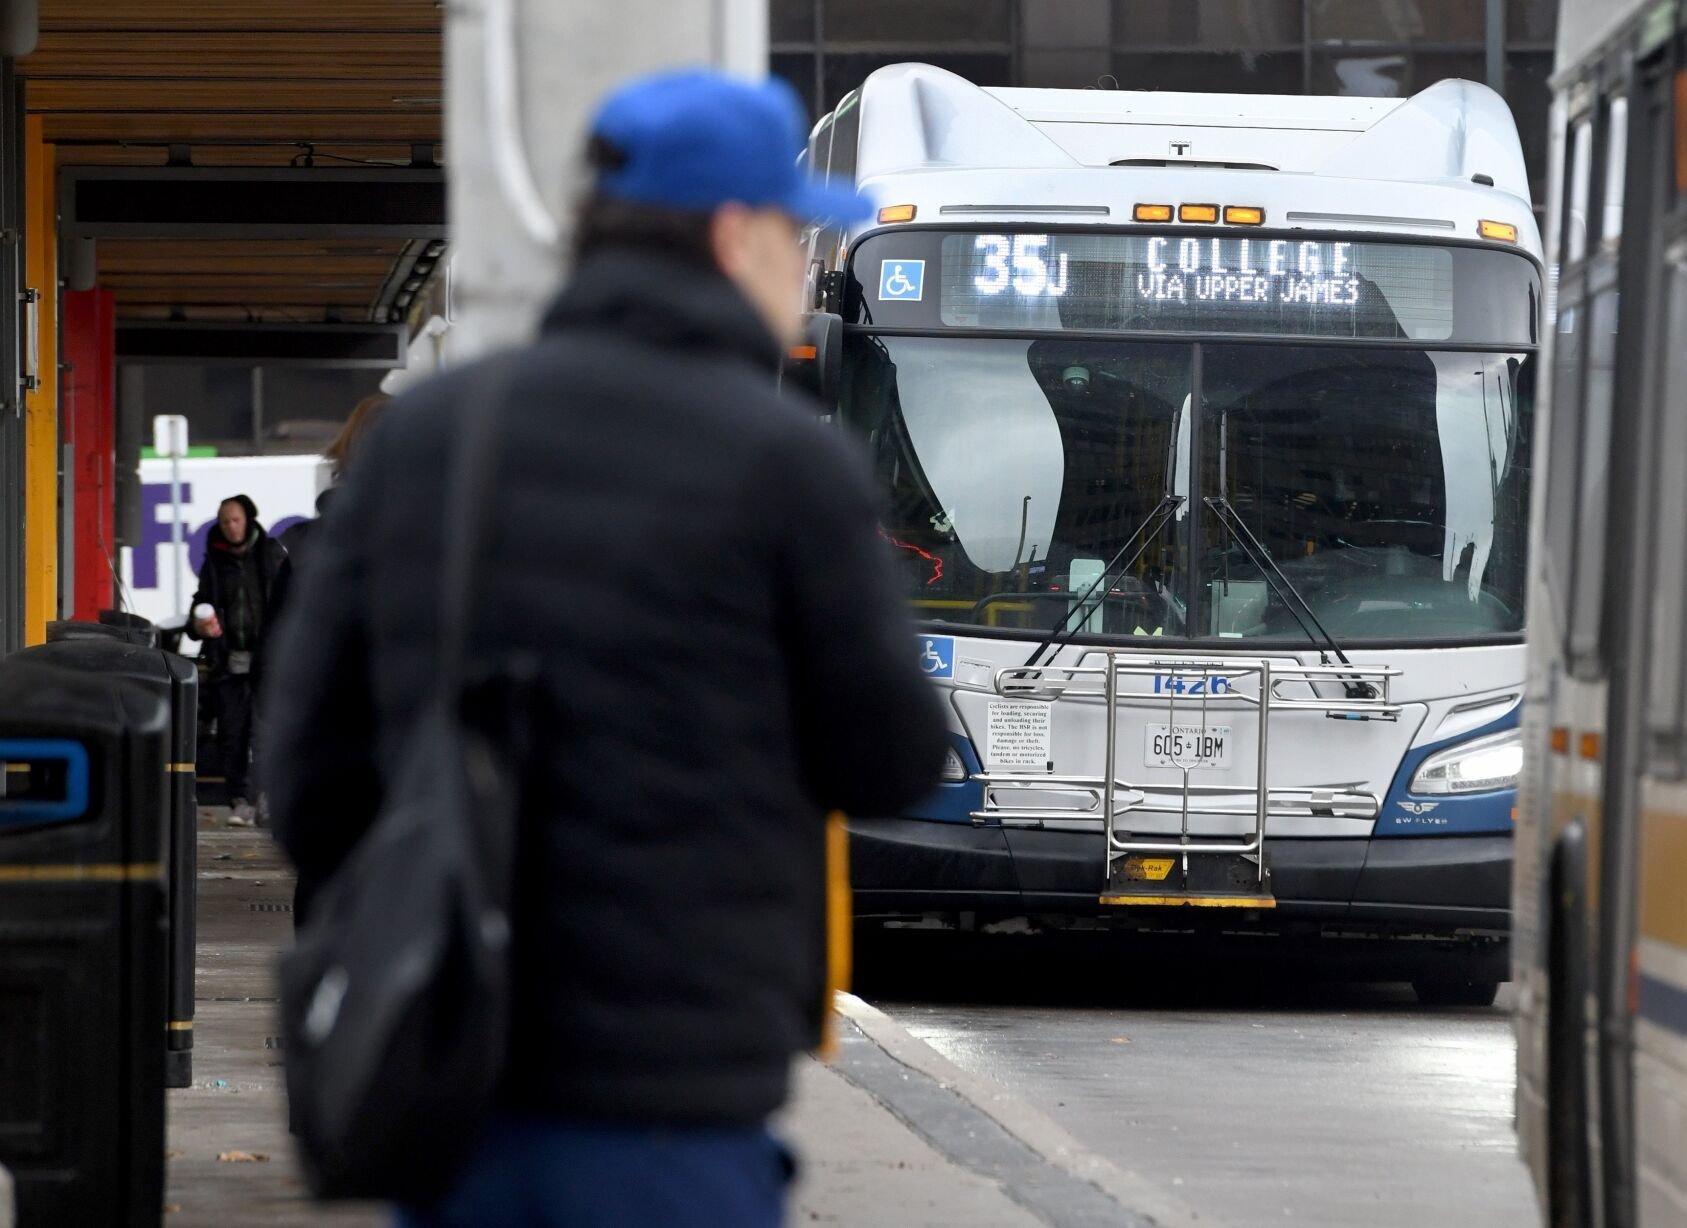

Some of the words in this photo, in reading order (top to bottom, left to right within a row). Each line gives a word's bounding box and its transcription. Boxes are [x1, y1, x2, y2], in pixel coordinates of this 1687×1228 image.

[1148, 237, 1351, 277] COLLEGE
[1138, 274, 1184, 299] VIA
[1196, 275, 1268, 301] UPPER
[1281, 277, 1360, 304] JAMES
[1154, 672, 1231, 694] 1426
